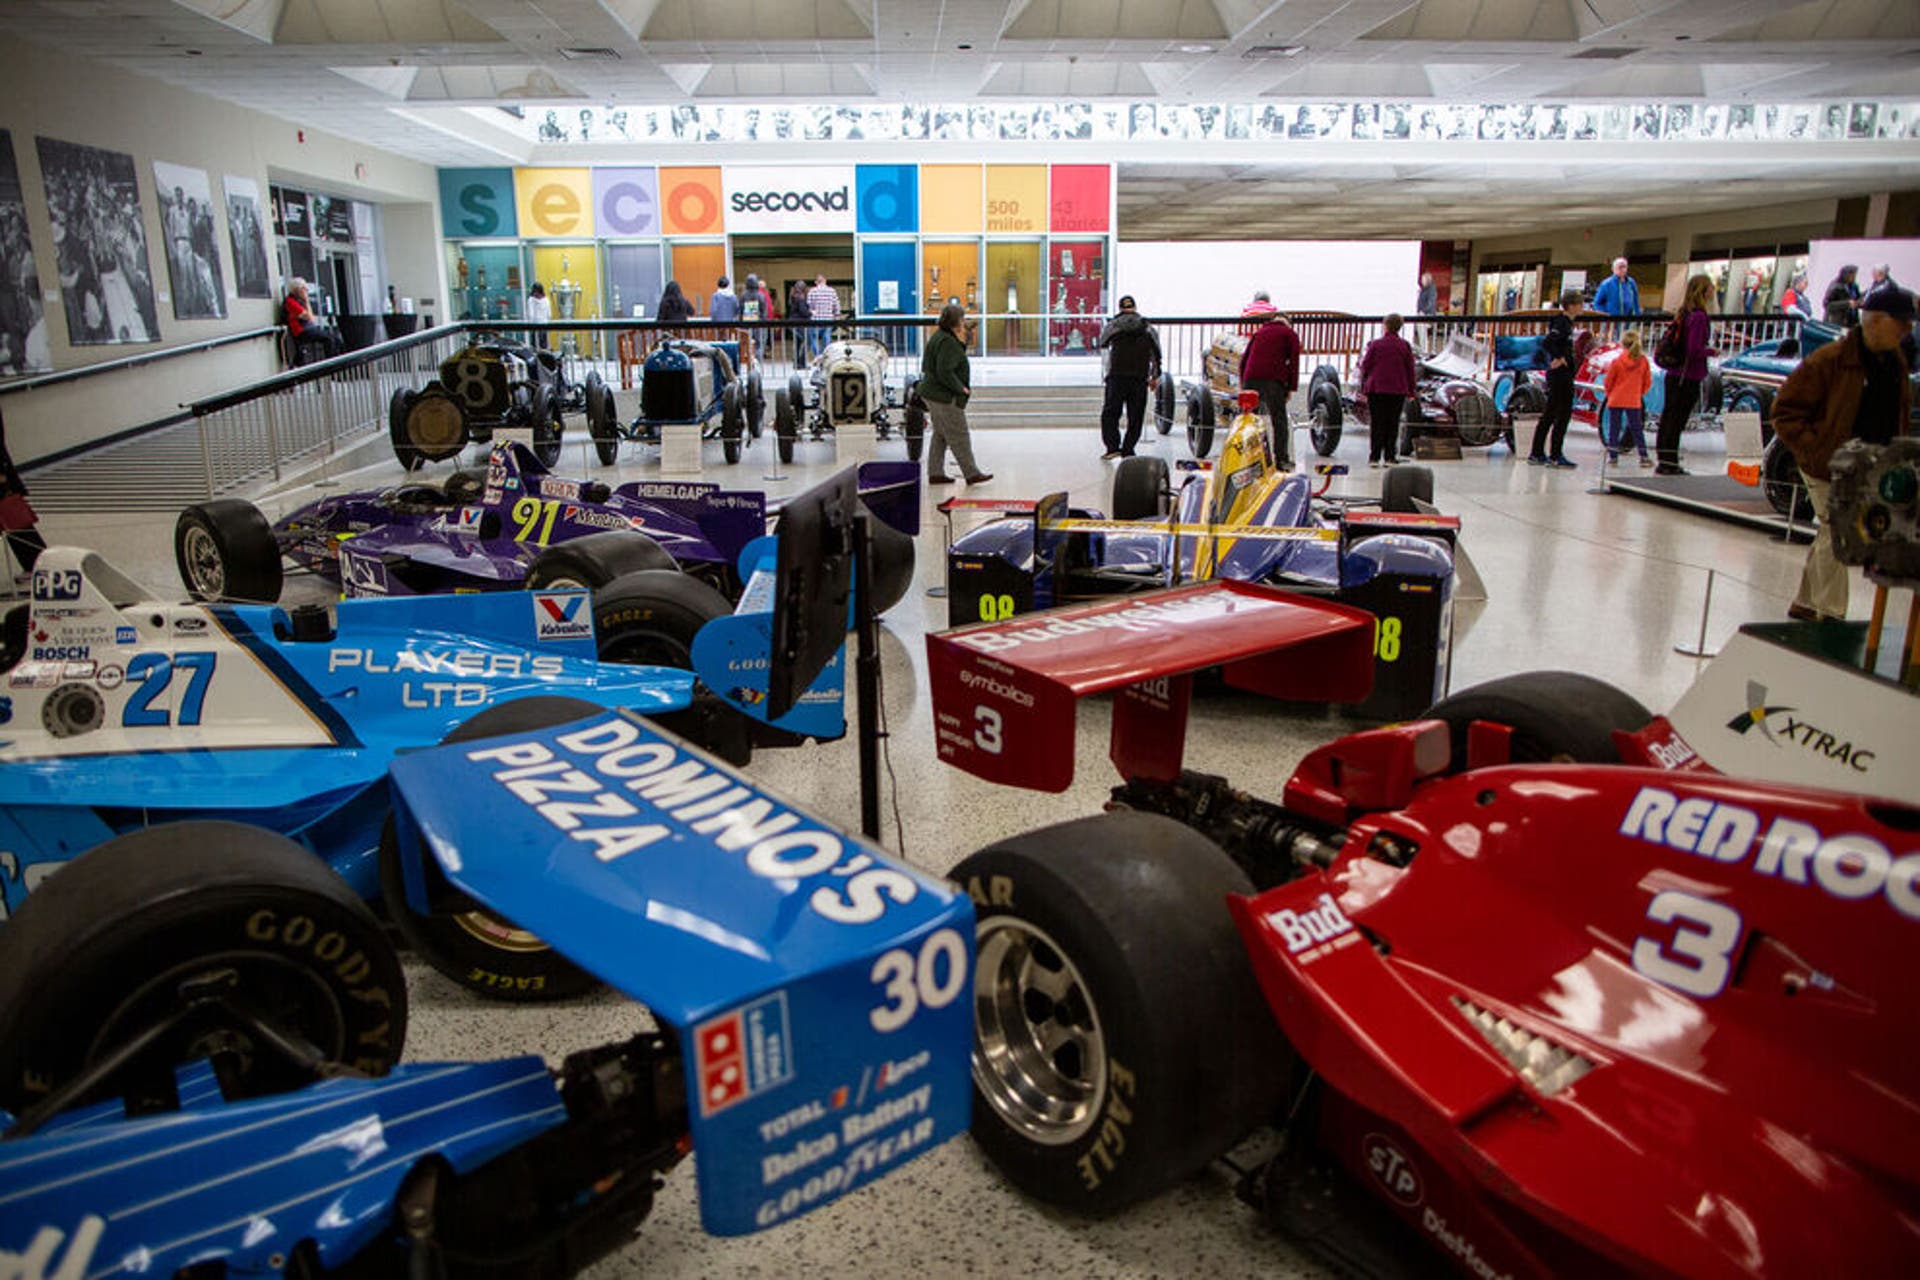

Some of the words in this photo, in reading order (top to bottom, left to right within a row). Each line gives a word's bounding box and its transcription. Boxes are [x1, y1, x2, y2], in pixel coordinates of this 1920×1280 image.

[731, 186, 848, 213] second
[987, 201, 1019, 215] 500
[987, 217, 1033, 232] miles
[457, 359, 494, 408] 8
[835, 379, 864, 415] 12
[512, 497, 562, 548] 91
[36, 572, 80, 598] PPG
[950, 588, 1243, 653] Budweiser
[33, 647, 90, 660] BOSCH
[329, 648, 564, 680] PLAYER'S
[122, 652, 218, 728] 27
[403, 682, 494, 709] LTD.
[974, 703, 1003, 754] 3
[1778, 716, 1876, 773] XTRAC
[466, 741, 672, 863] PIZZA
[556, 718, 918, 925] DOMINO'S
[1618, 786, 1760, 864] RED
[1267, 892, 1354, 953] Bud
[1630, 890, 1743, 999] 3
[869, 927, 968, 1033] 30
[762, 1132, 838, 1184] Delco
[841, 1083, 933, 1144] Battery
[1076, 1058, 1136, 1190] EAGLE
[756, 1116, 935, 1226] GOODYEAR
[1369, 1147, 1416, 1194] STP
